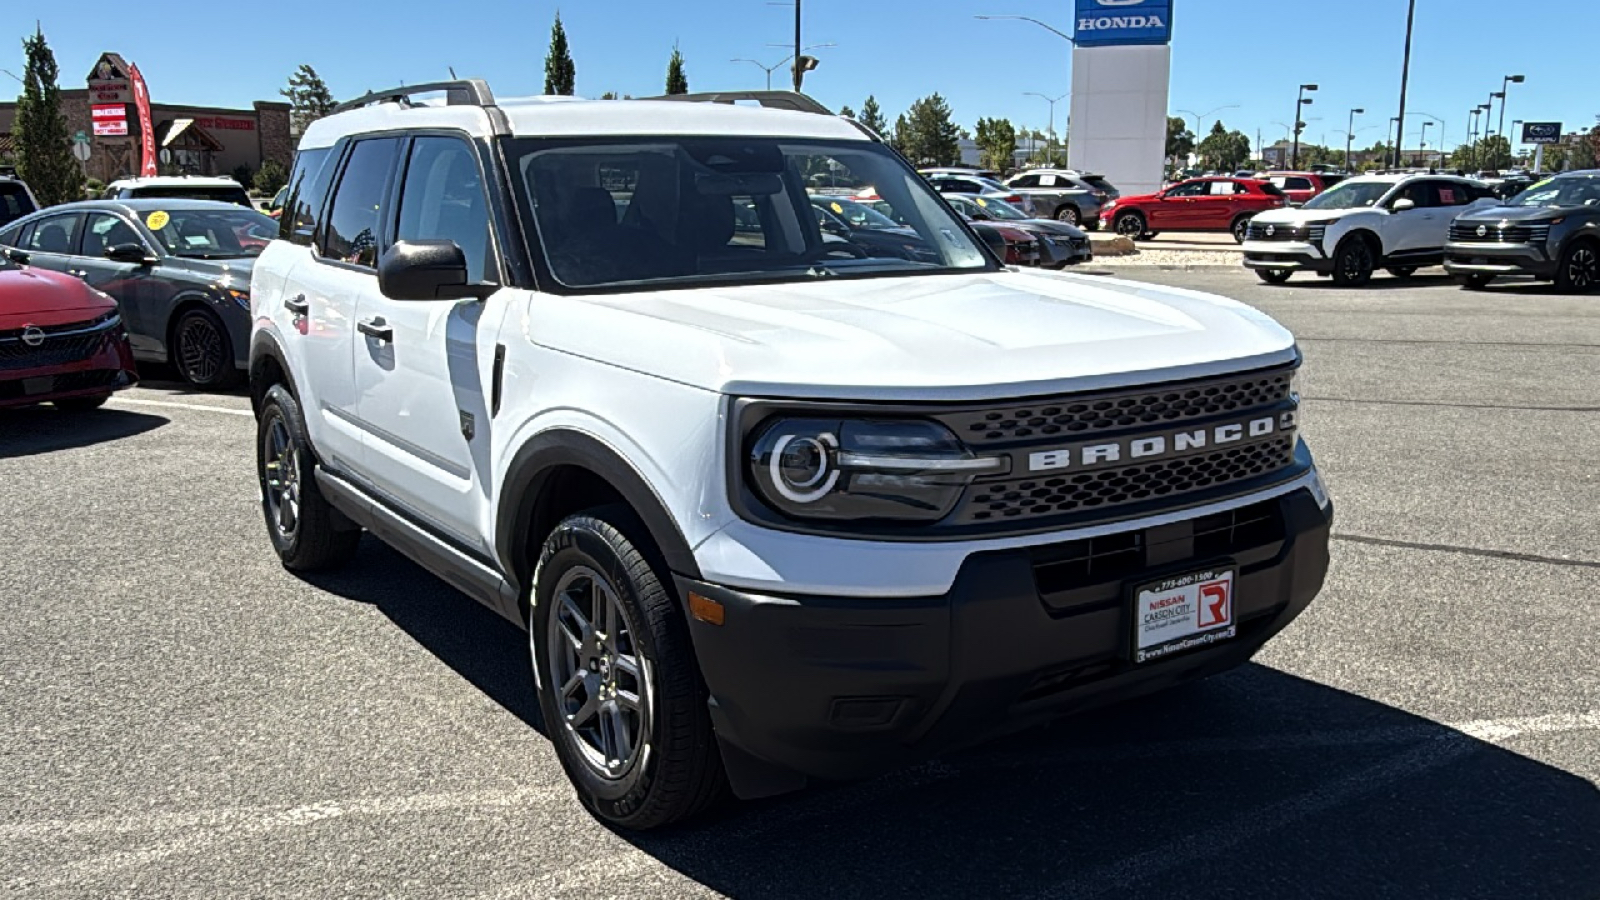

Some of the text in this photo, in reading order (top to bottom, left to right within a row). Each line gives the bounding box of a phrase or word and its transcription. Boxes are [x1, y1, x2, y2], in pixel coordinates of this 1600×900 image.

[1078, 15, 1165, 31] HONDA
[1028, 416, 1274, 471] BRONCO
[1149, 594, 1186, 611] NISSAN
[1144, 603, 1191, 624] CARSON CITY
